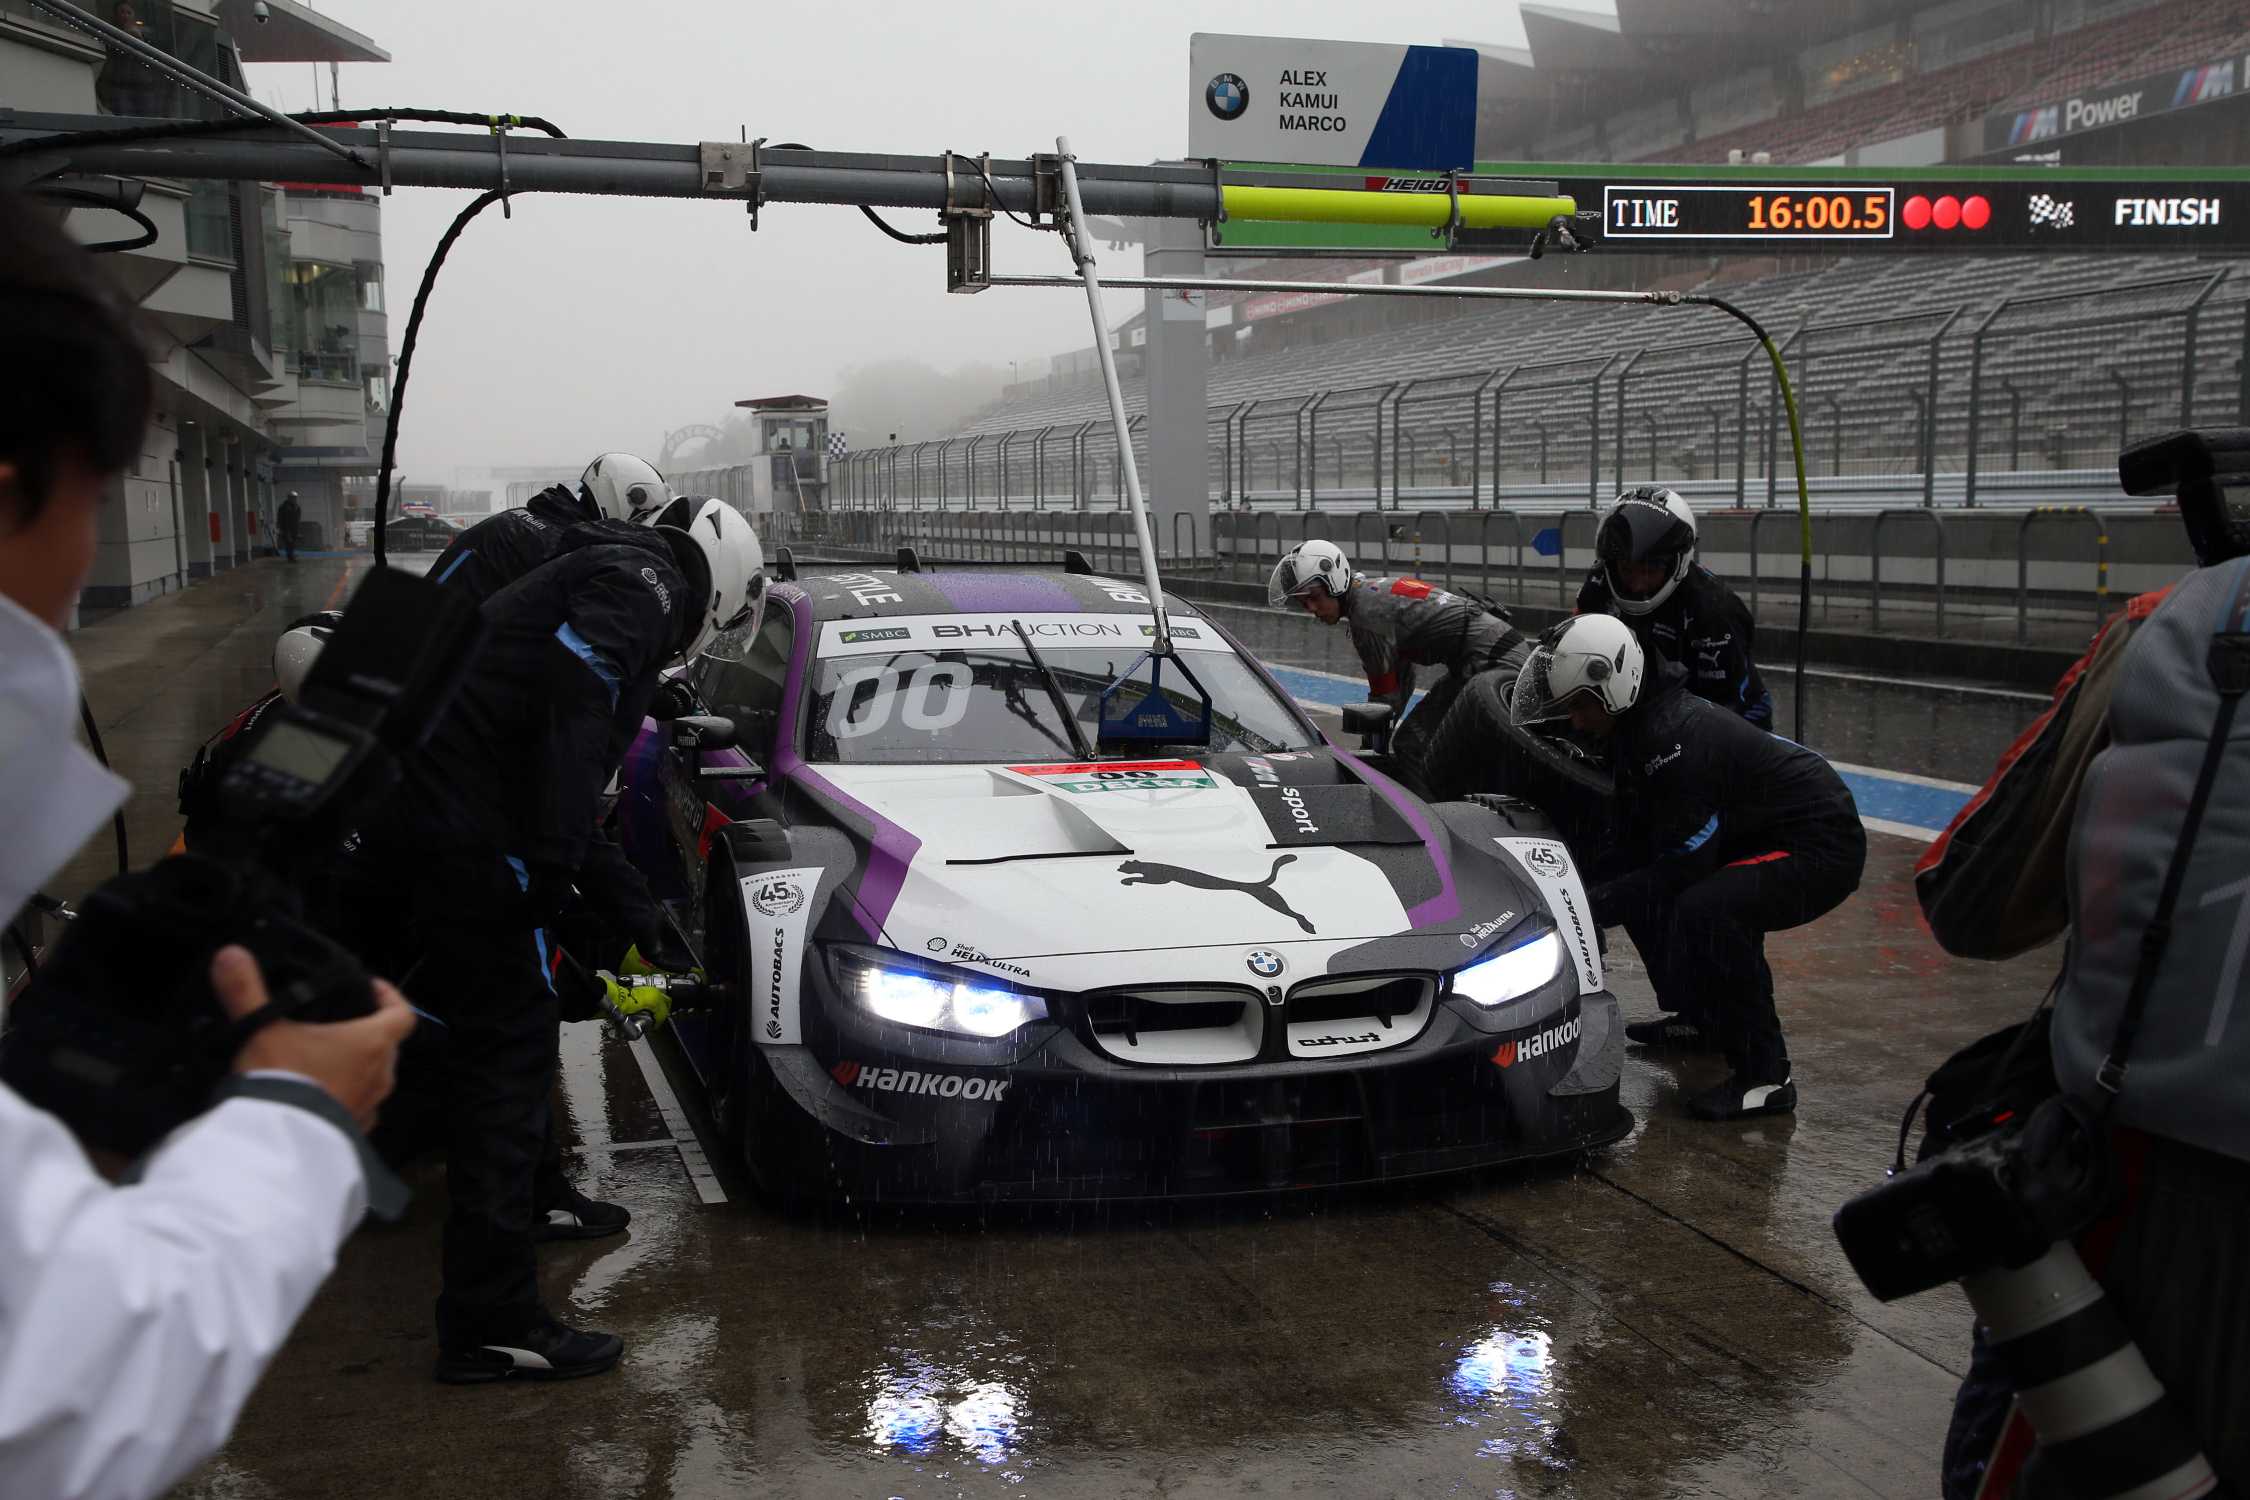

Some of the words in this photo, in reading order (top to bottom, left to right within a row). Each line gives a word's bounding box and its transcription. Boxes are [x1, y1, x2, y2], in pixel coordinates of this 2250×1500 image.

[1280, 70, 1327, 86] ALEX
[1280, 92, 1338, 109] KAMUI
[2066, 92, 2143, 131] Power
[1279, 115, 1346, 132] MARCO
[1383, 178, 1452, 193] HEIGO
[1613, 199, 1680, 228] TIME
[1748, 196, 1886, 229] 16:00.5
[2114, 198, 2220, 226] FINISH
[861, 629, 908, 640] SMBC
[826, 661, 974, 738] 00
[1074, 778, 1209, 792] DEKRA
[1281, 787, 1319, 833] sport
[1560, 888, 1594, 969] AUTOBACS
[956, 943, 974, 952] Shell
[771, 927, 784, 1019] AUTOBACS
[992, 960, 1031, 977] ULTRA
